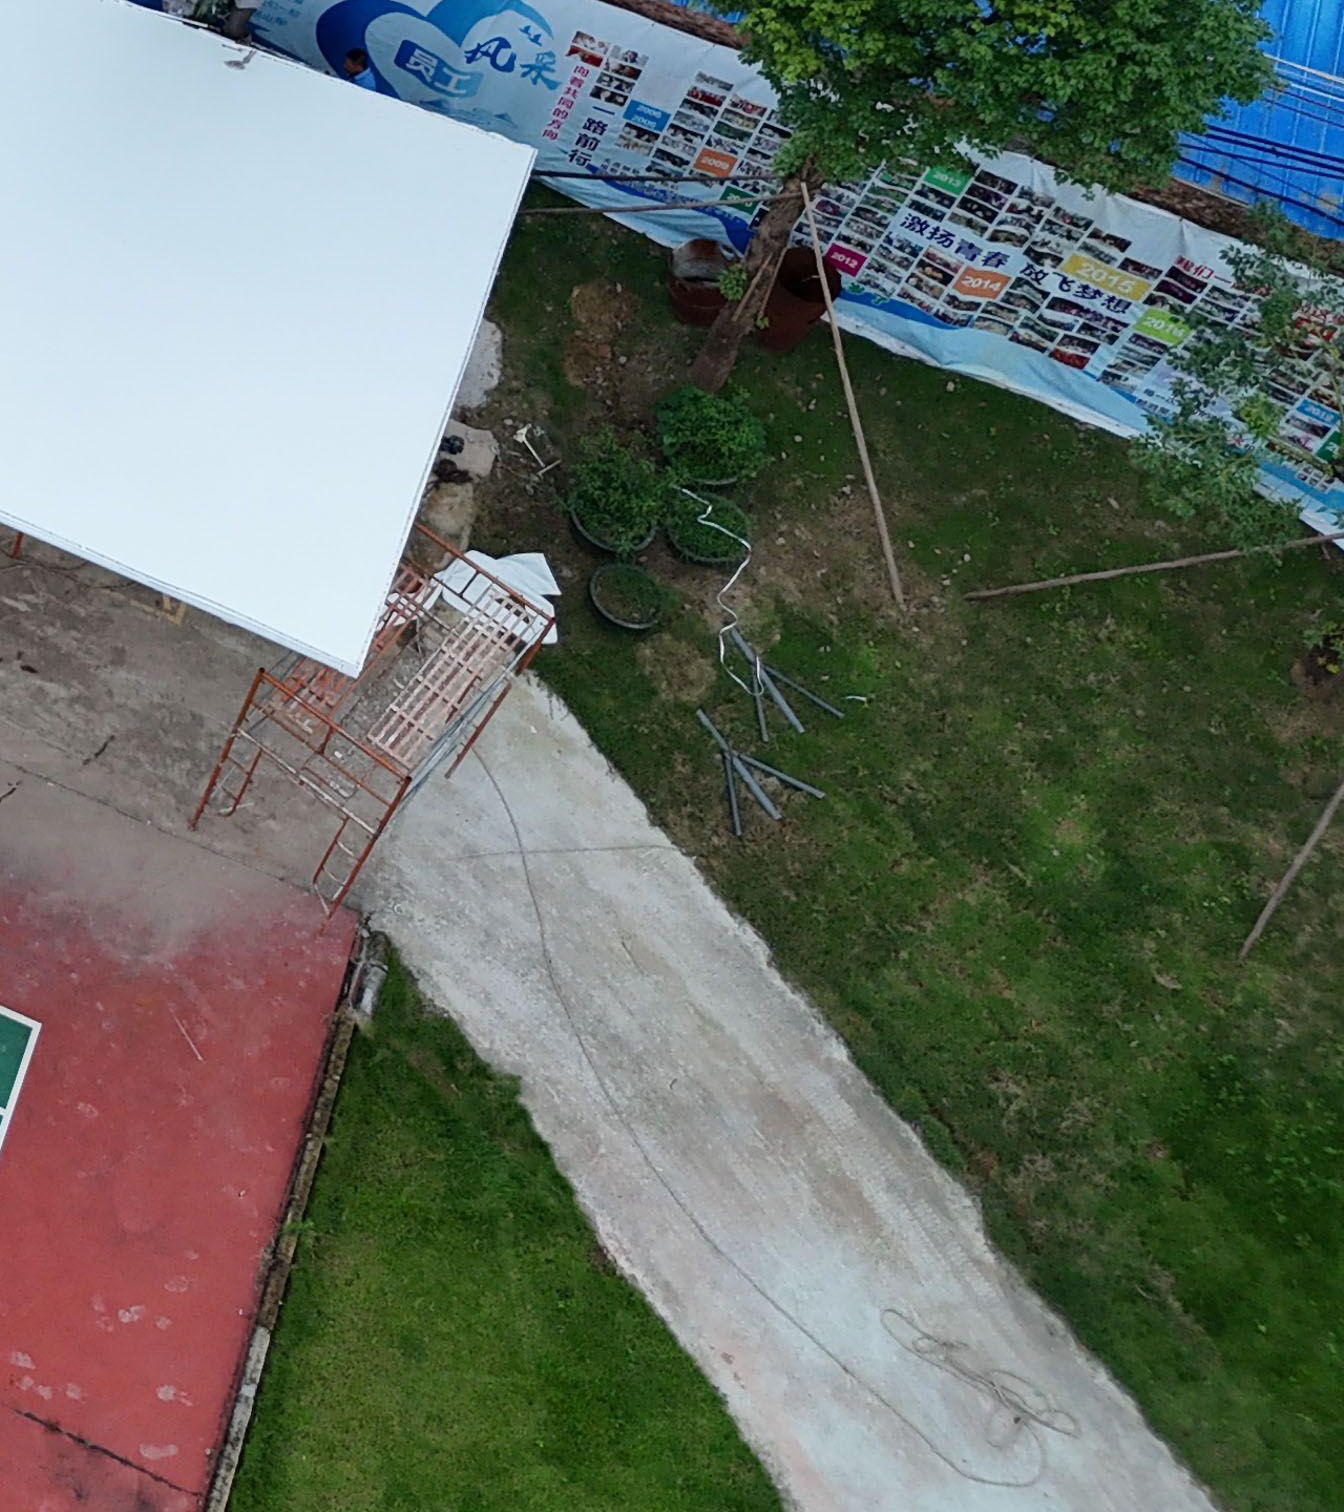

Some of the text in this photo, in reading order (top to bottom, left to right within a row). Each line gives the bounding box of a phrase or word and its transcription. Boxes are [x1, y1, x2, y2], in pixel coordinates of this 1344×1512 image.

[406, 48, 472, 95] 员工
[464, 36, 561, 90] 风采
[542, 65, 590, 141] 向着共同的方向
[568, 105, 616, 167] 一路前行
[830, 251, 859, 268] 2012
[899, 212, 1133, 314] 激扬青春 放飞梦想
[961, 275, 1003, 292] 2014
